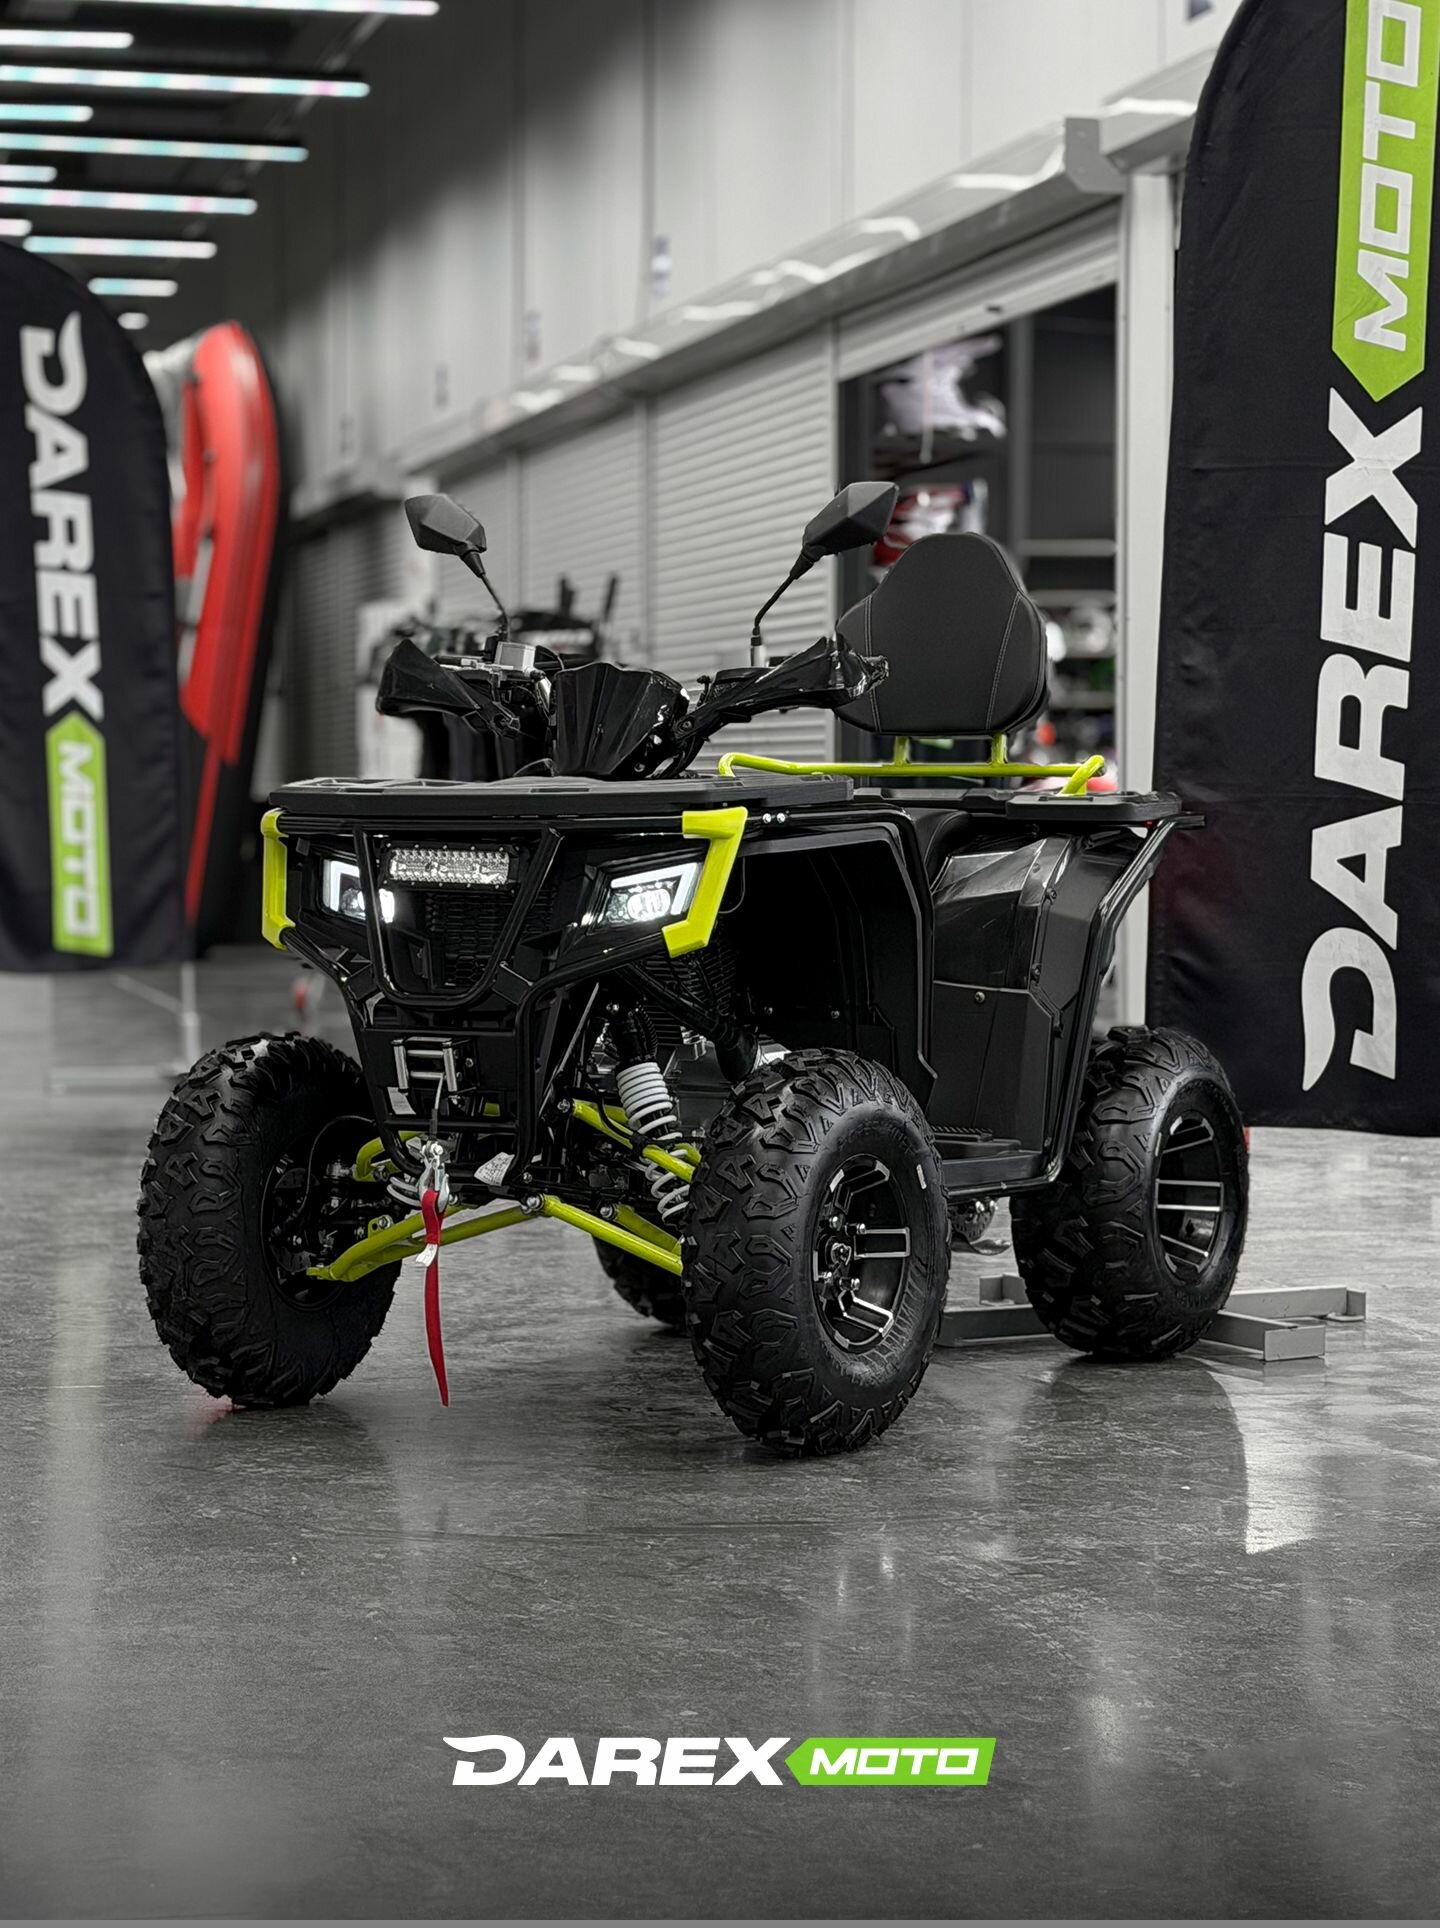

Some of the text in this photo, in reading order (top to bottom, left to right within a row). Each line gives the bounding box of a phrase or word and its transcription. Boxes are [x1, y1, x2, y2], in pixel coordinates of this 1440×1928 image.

[21, 311, 104, 938] DAREX MOTO
[1302, 0, 1422, 1090] DAREX MOTO
